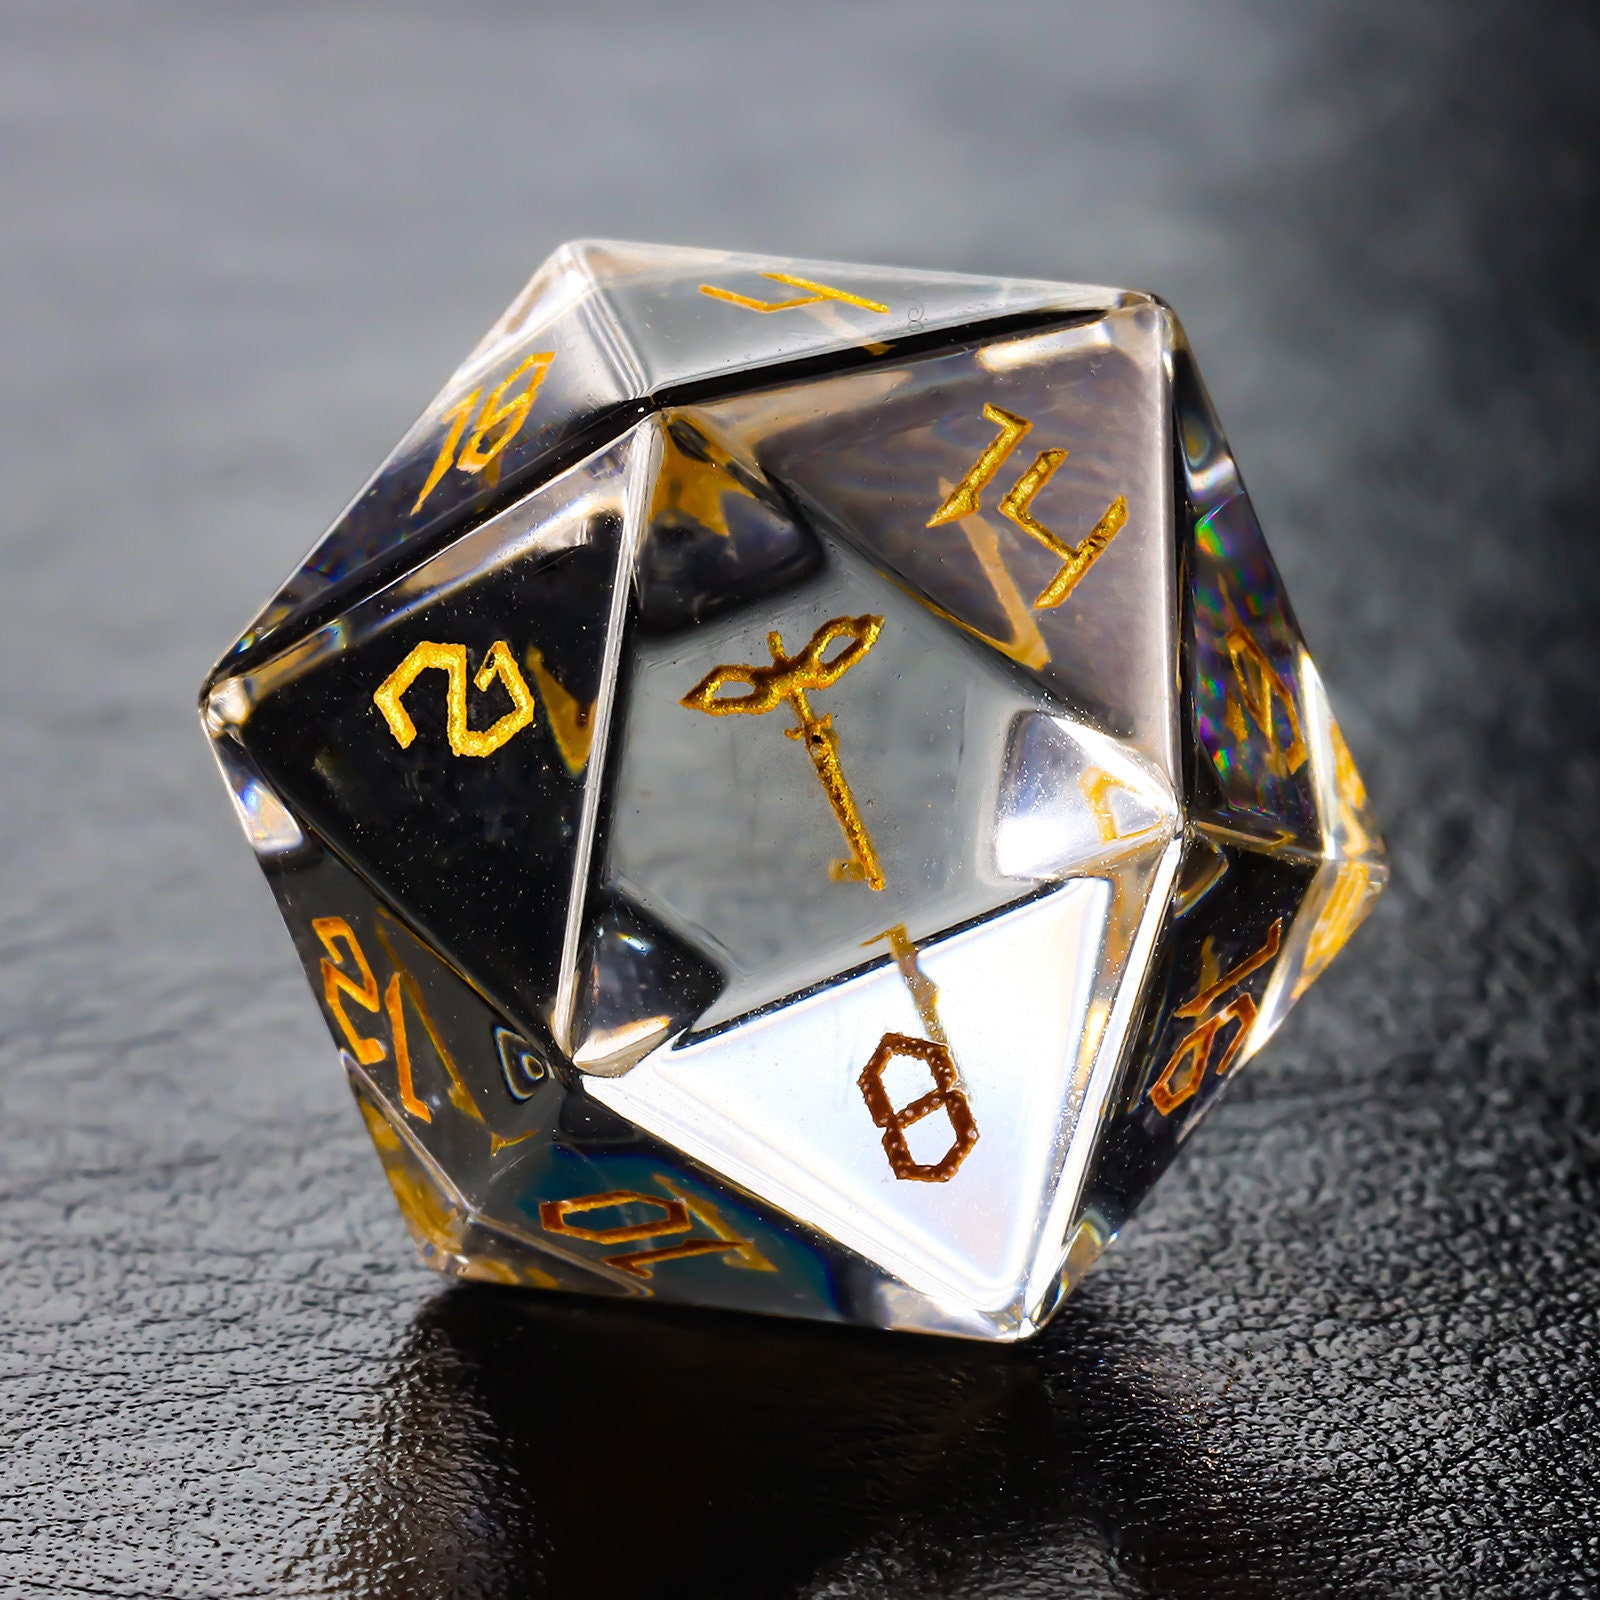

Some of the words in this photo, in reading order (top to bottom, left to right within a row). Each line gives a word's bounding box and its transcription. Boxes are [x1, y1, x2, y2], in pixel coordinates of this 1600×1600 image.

[699, 272, 889, 314] 4
[410, 351, 555, 516] 18
[926, 402, 1128, 609] 14
[374, 640, 536, 759] 2
[312, 916, 432, 1124] 12
[857, 1032, 980, 1182] 8
